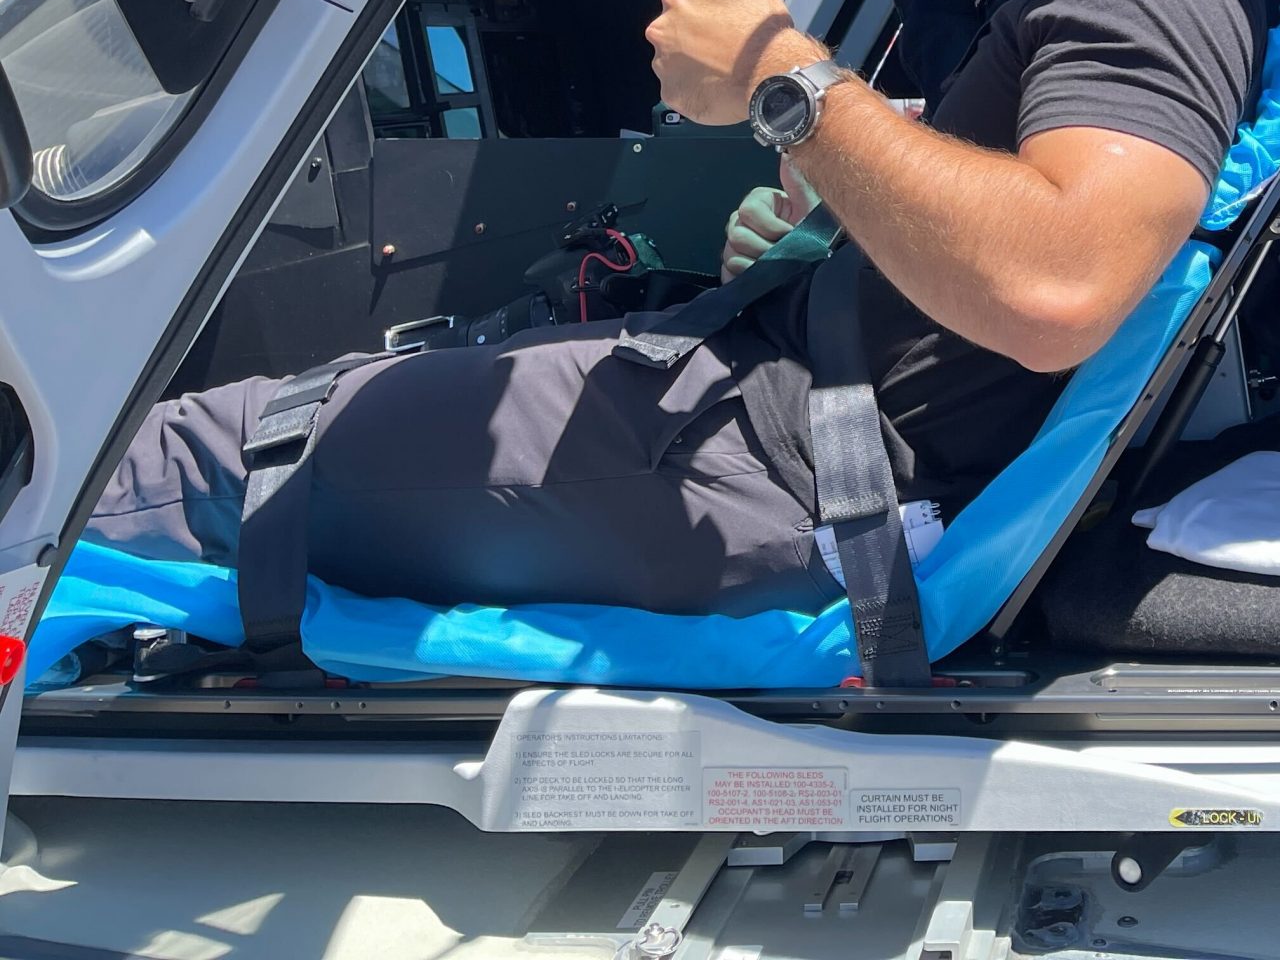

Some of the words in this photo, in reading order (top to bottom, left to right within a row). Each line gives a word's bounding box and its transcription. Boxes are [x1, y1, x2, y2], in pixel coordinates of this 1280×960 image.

[861, 794, 901, 803] CURTAIN
[903, 794, 929, 802] MUST
[931, 794, 944, 802] BE
[718, 808, 771, 816] OCCUPANT'S
[772, 808, 795, 816] HEAD
[797, 808, 820, 816] MUST
[822, 808, 833, 816] BE
[856, 805, 905, 813] INSTALLED
[907, 804, 928, 813] FOR
[929, 804, 958, 812] NIGHT
[709, 817, 751, 825] ORIENTED
[753, 817, 761, 825] IN
[763, 817, 778, 825] THE
[780, 817, 795, 825] AFT
[798, 817, 843, 825] DIRECTION
[859, 815, 891, 823] FLIGHT
[893, 814, 954, 822] OPERATIONS
[1203, 812, 1238, 824] LOCK
